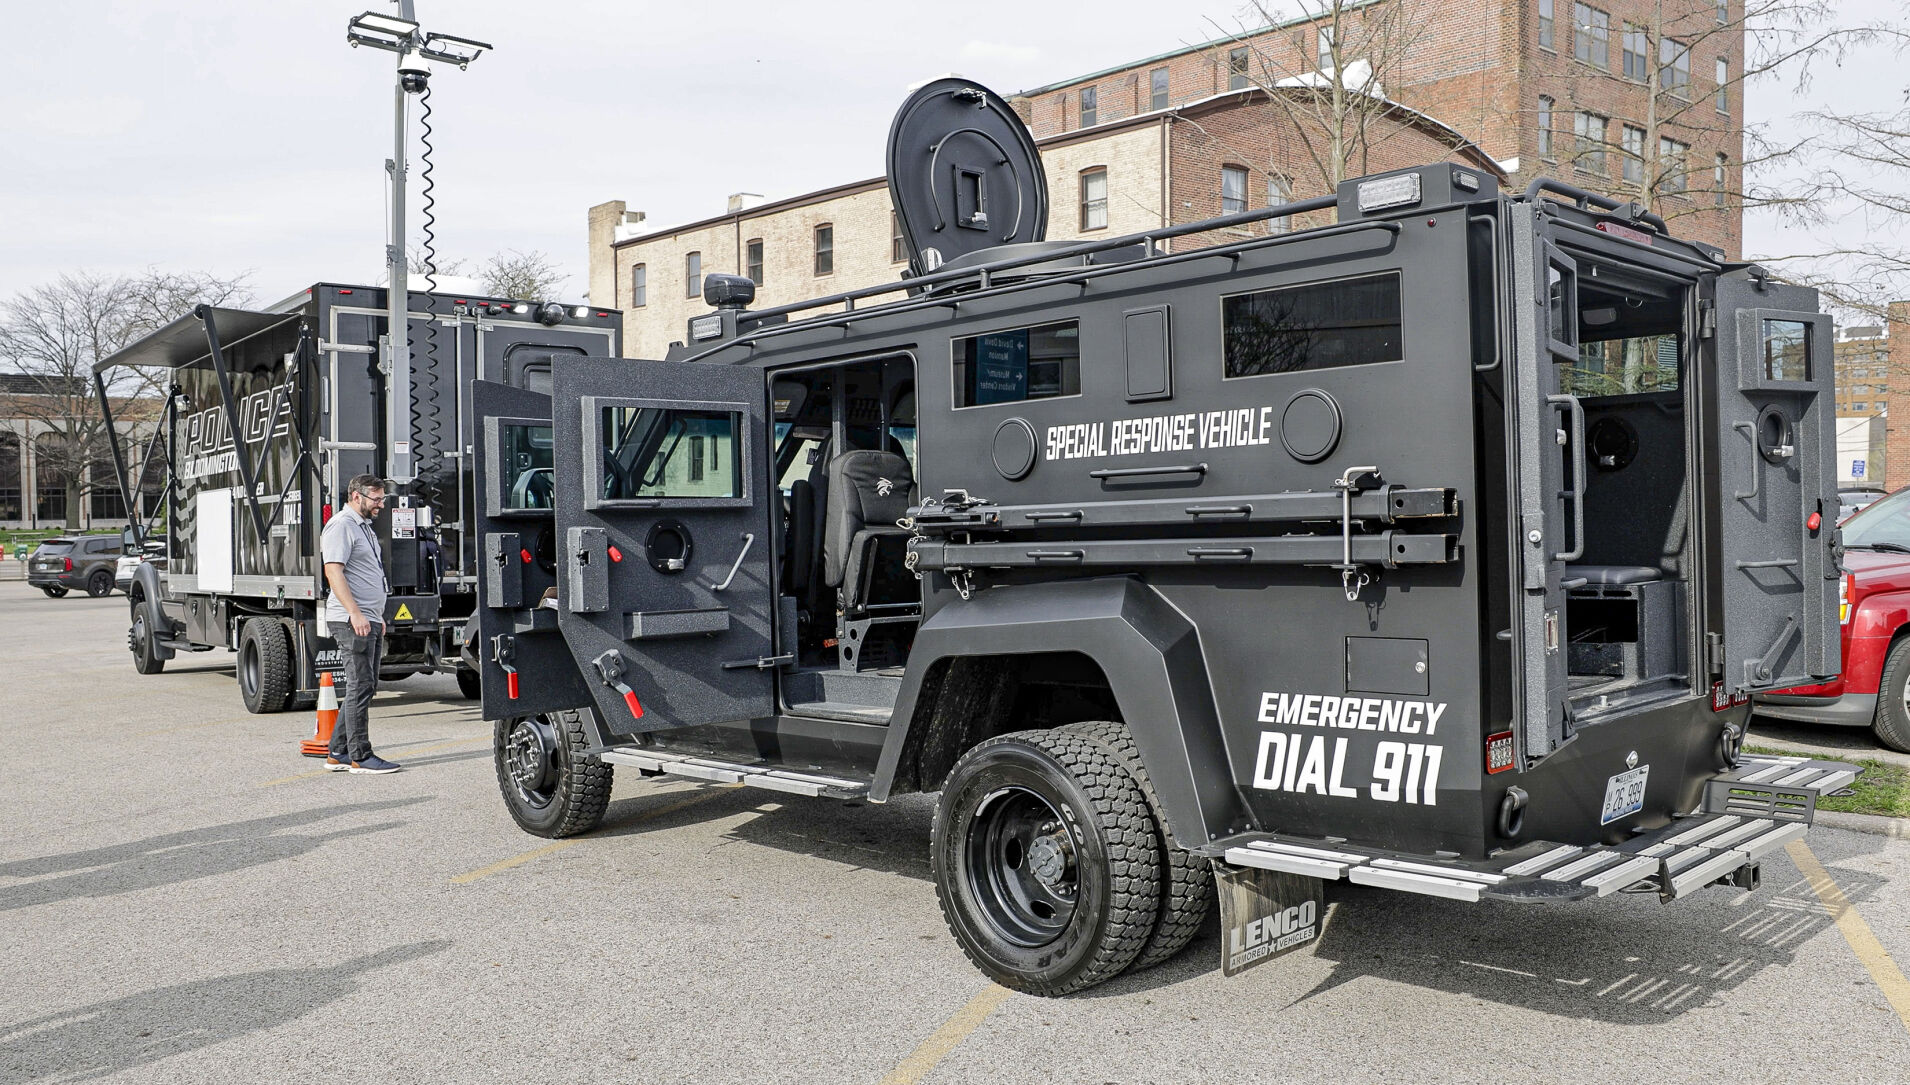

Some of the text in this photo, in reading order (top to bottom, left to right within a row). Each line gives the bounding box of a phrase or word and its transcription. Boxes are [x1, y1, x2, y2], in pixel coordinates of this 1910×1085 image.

[184, 381, 294, 459] POLICE
[1046, 407, 1273, 460] SPECIAL RESPONSE VEHICLE
[1257, 692, 1447, 735] EMERGENCY
[1253, 731, 1443, 806] DIAL 911
[1613, 787, 1625, 811] 26
[1230, 900, 1316, 956] LENCO
[1231, 928, 1313, 966] ARMORED VEHICLES
